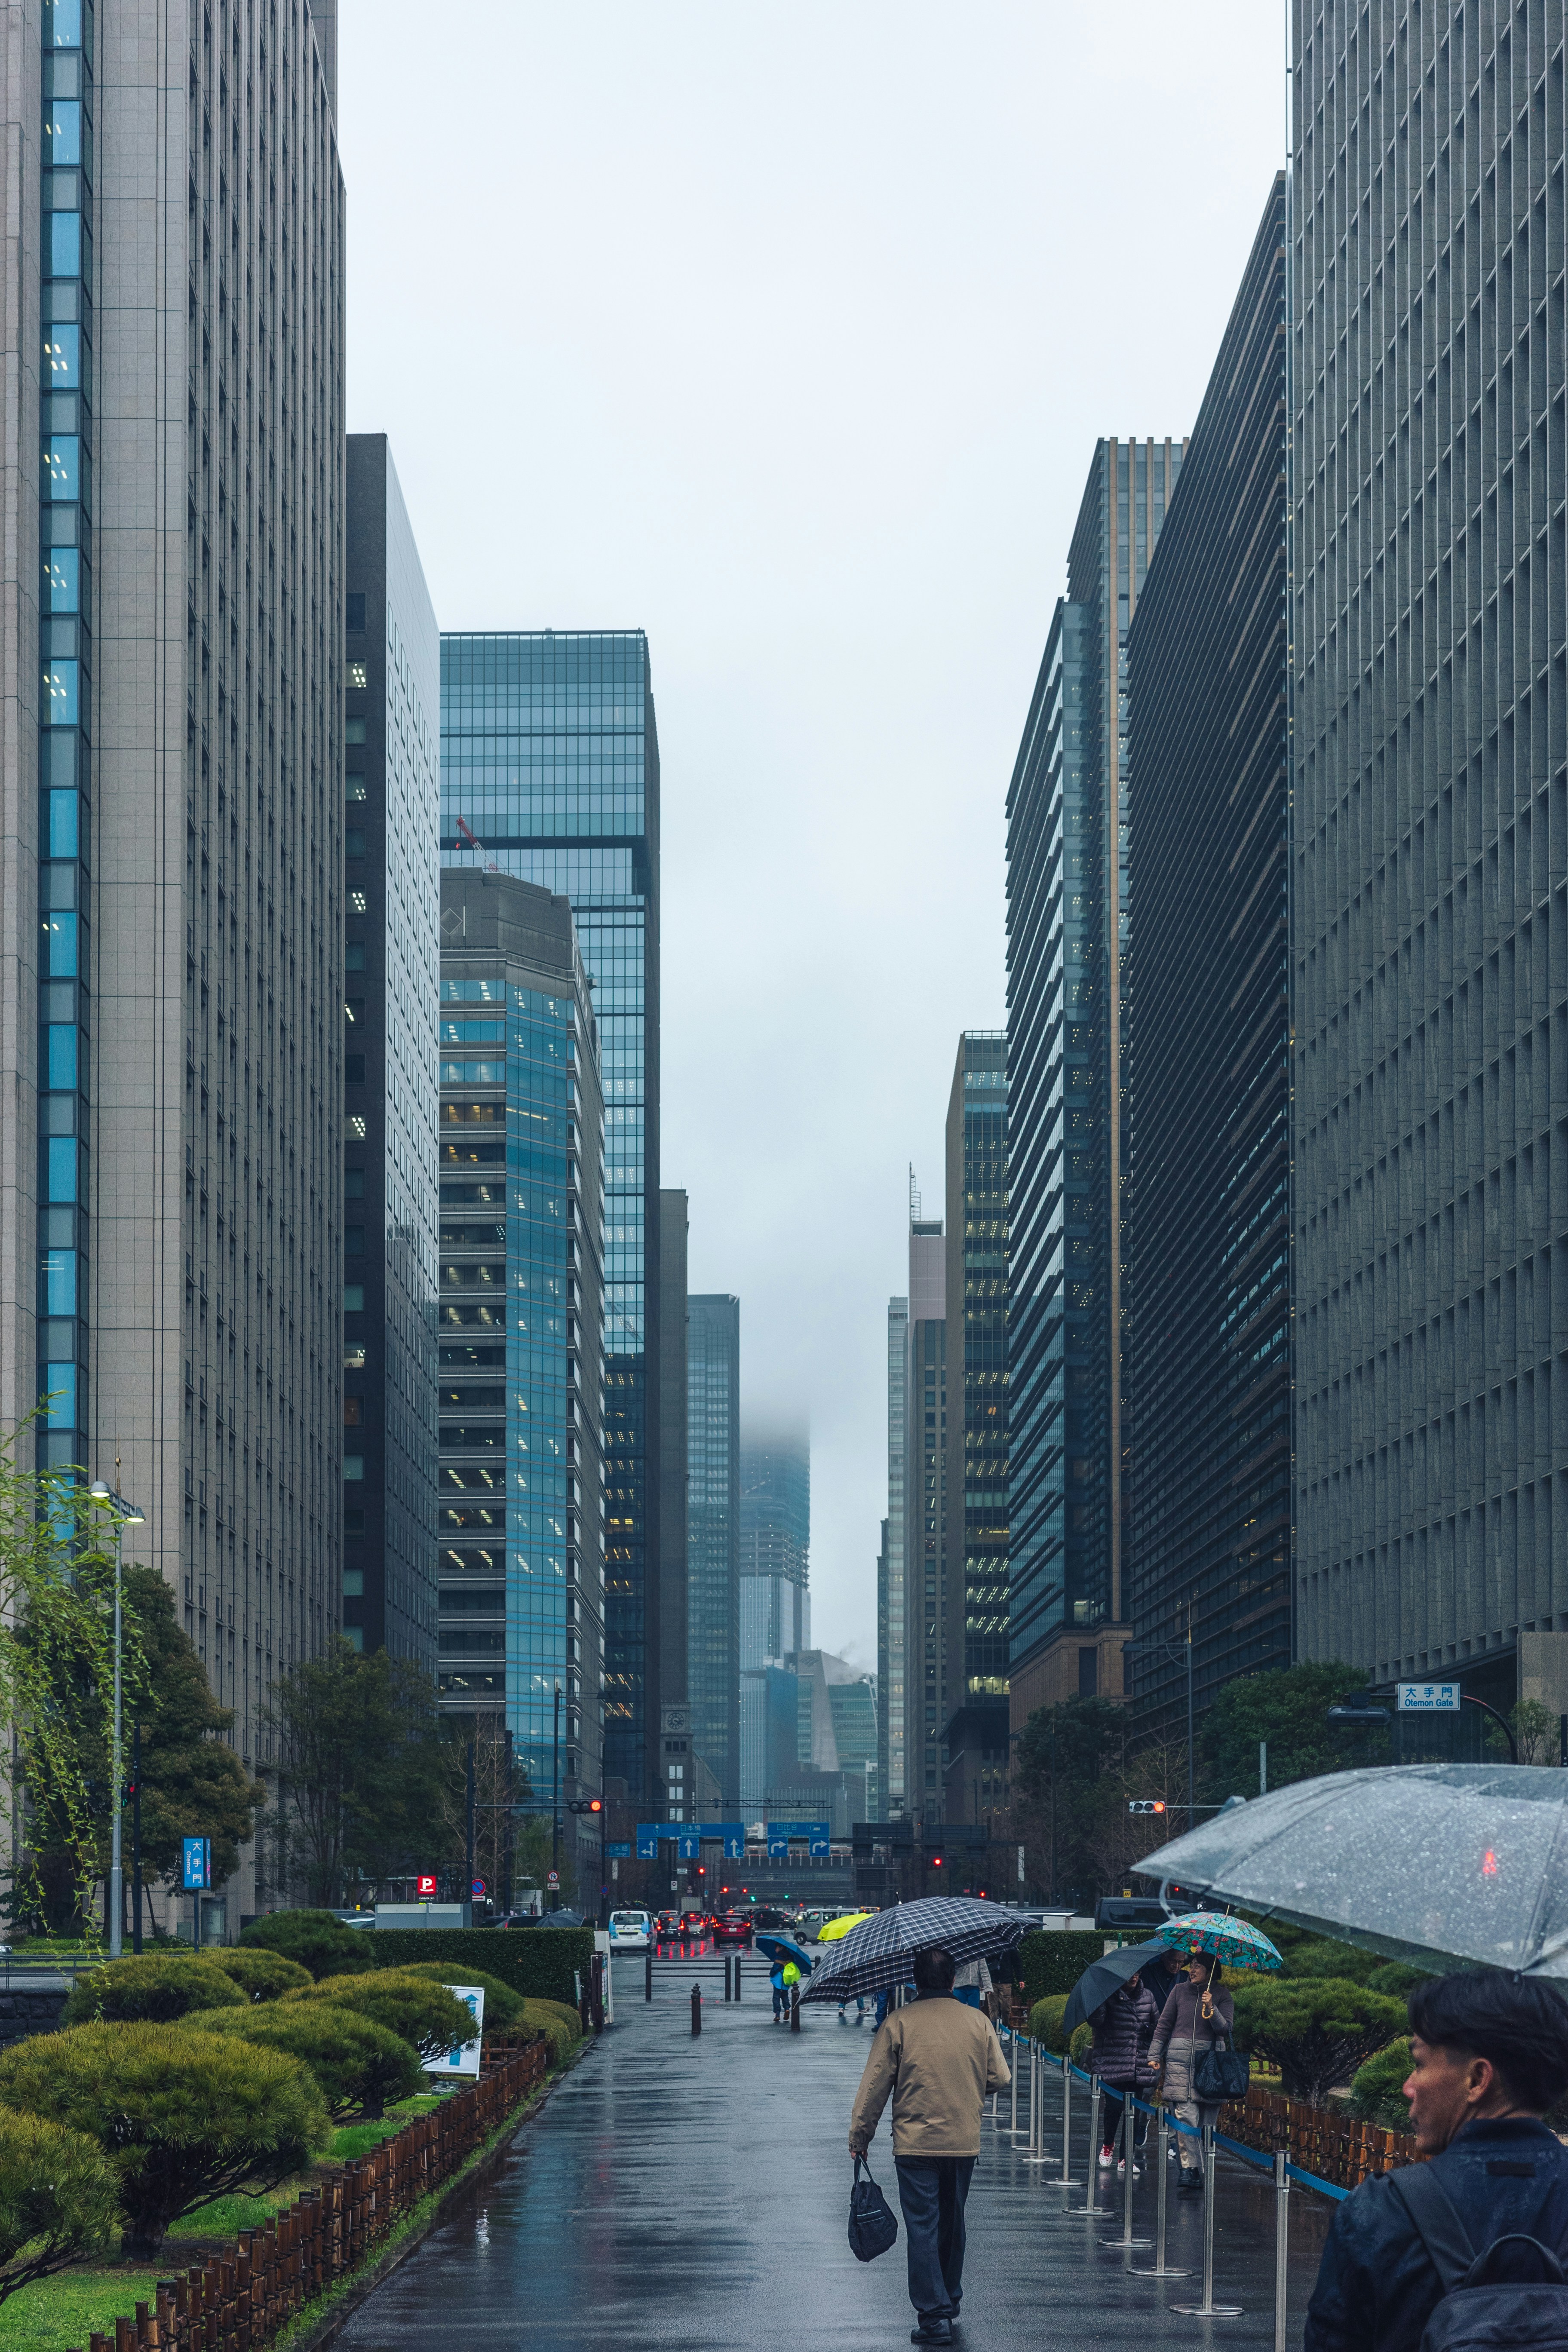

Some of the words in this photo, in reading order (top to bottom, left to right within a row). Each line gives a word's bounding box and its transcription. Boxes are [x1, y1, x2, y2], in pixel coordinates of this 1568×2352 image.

[1405, 1687, 1452, 1698] 大手門
[1405, 1699, 1433, 1707] Otemon
[1436, 1699, 1453, 1707] Gate
[192, 1842, 202, 1883] 大手門
[422, 1878, 433, 1889] P
